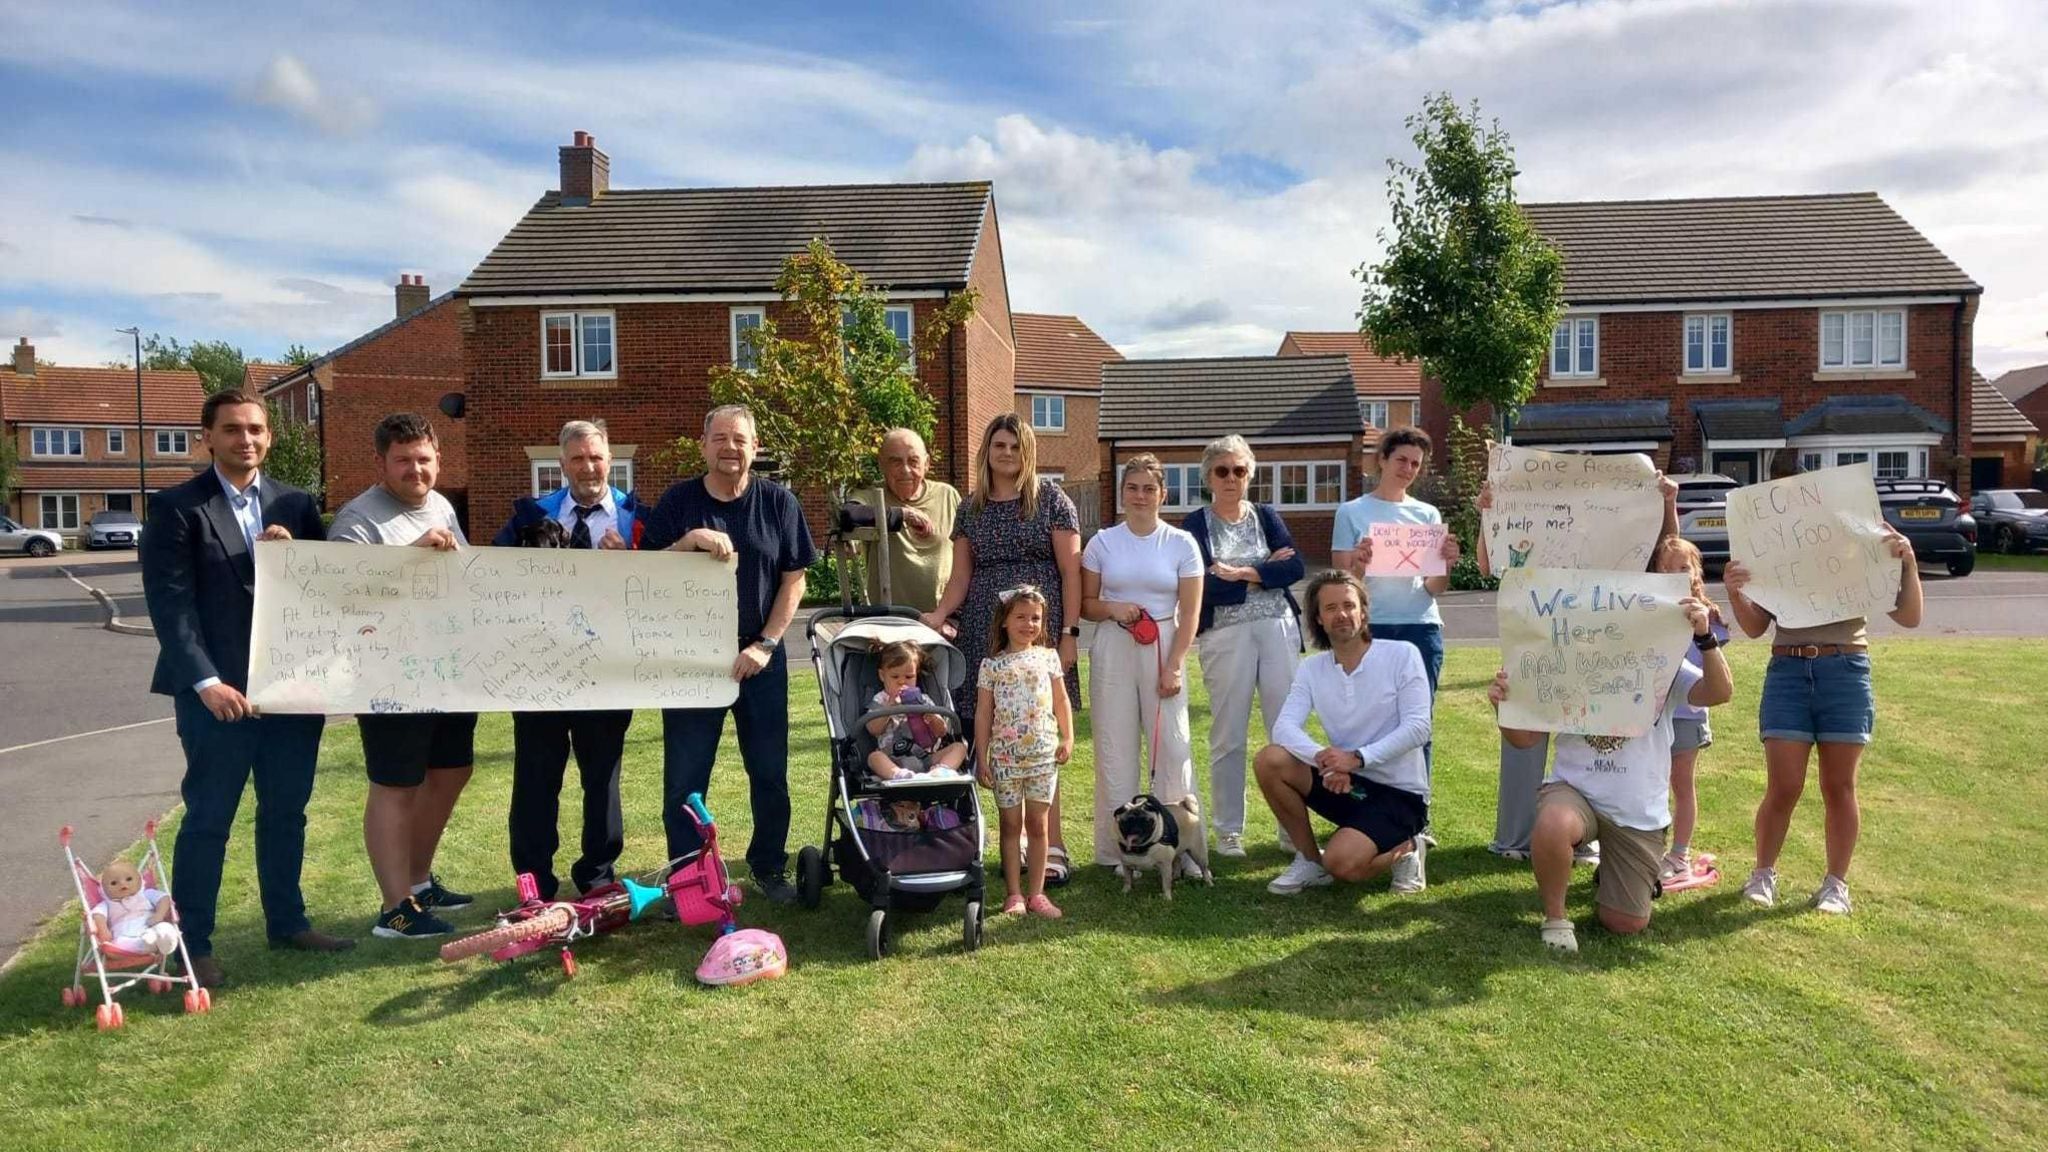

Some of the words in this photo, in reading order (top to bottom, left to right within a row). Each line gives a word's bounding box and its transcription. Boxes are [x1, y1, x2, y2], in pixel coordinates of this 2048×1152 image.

[1506, 516, 1534, 534] help
[625, 575, 673, 606] Alec
[312, 604, 330, 618] the
[1530, 588, 1581, 617] We
[1551, 617, 1625, 647] Here
[305, 642, 322, 658] the
[305, 664, 328, 679] help
